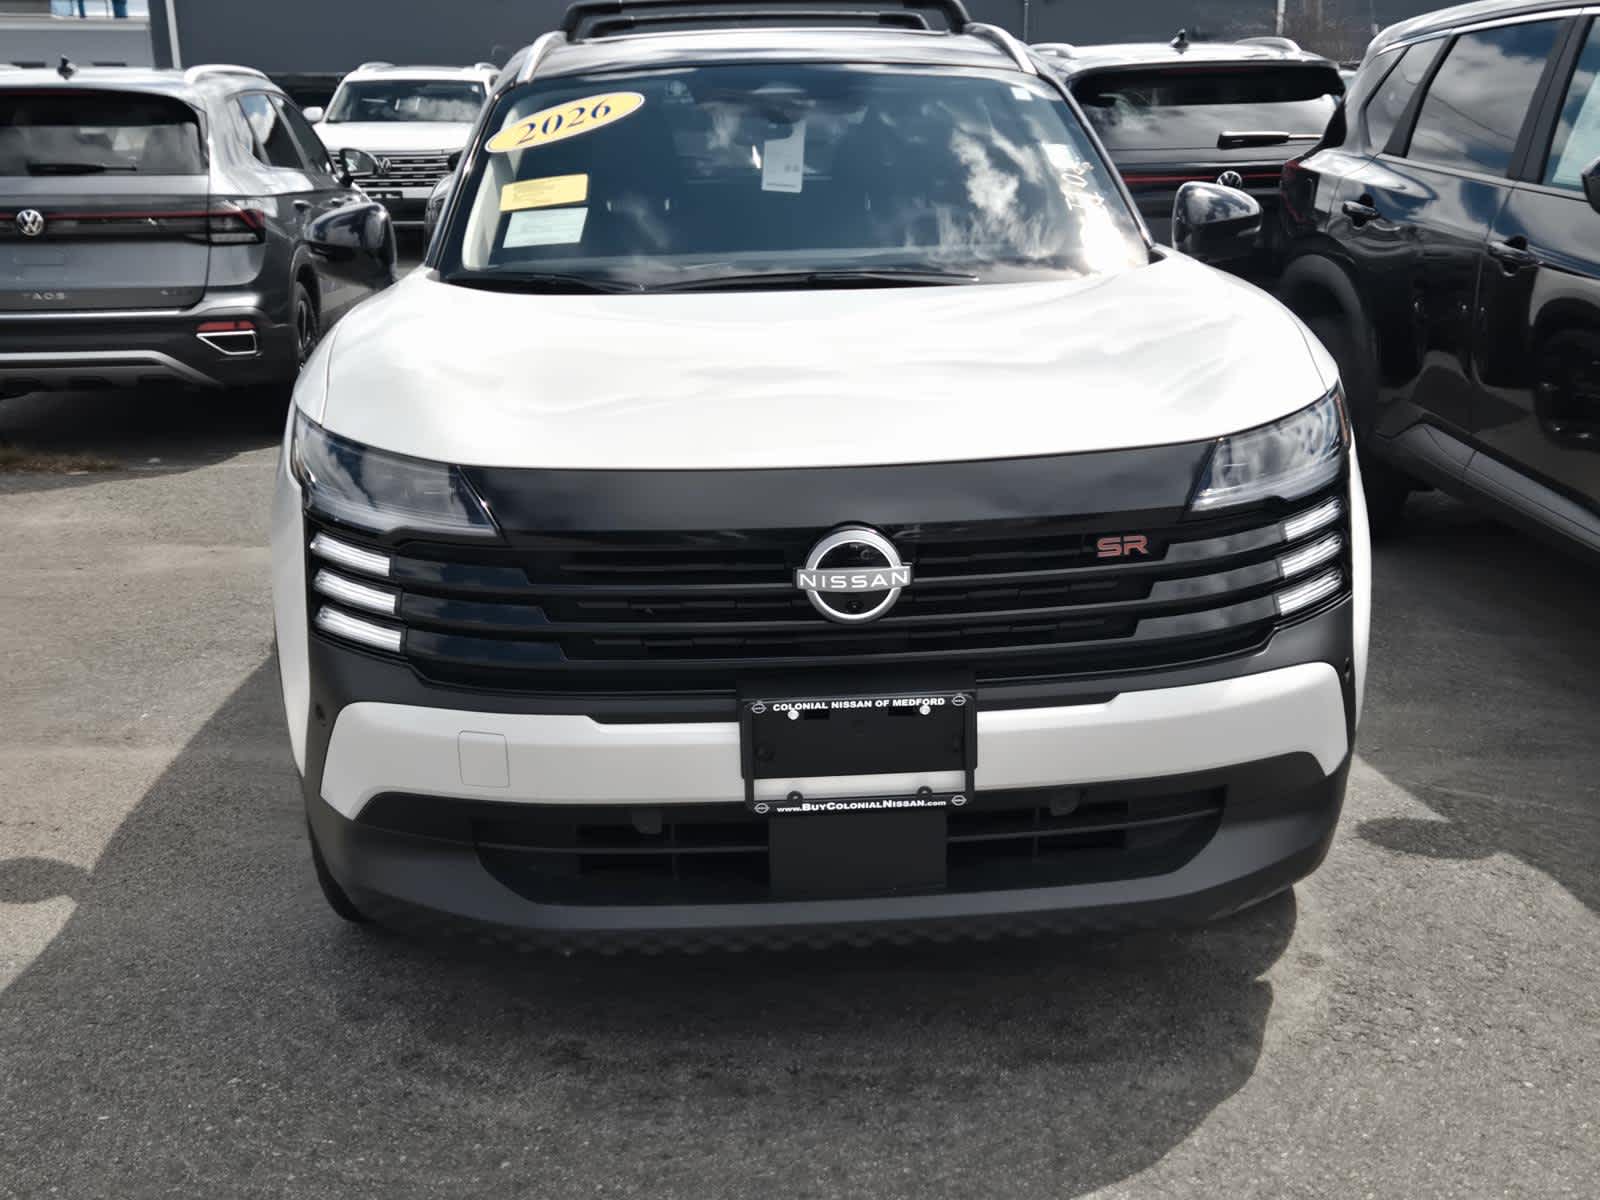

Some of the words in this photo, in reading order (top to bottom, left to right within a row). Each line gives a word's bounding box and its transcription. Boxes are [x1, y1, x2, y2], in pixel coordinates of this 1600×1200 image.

[516, 99, 612, 145] 2026
[1096, 535, 1149, 558] SR
[799, 570, 910, 589] NISSAN
[772, 702, 829, 712] COLONIAL
[831, 700, 873, 710] NISSAN
[874, 699, 890, 708] OF
[892, 697, 946, 707] MEDFORD
